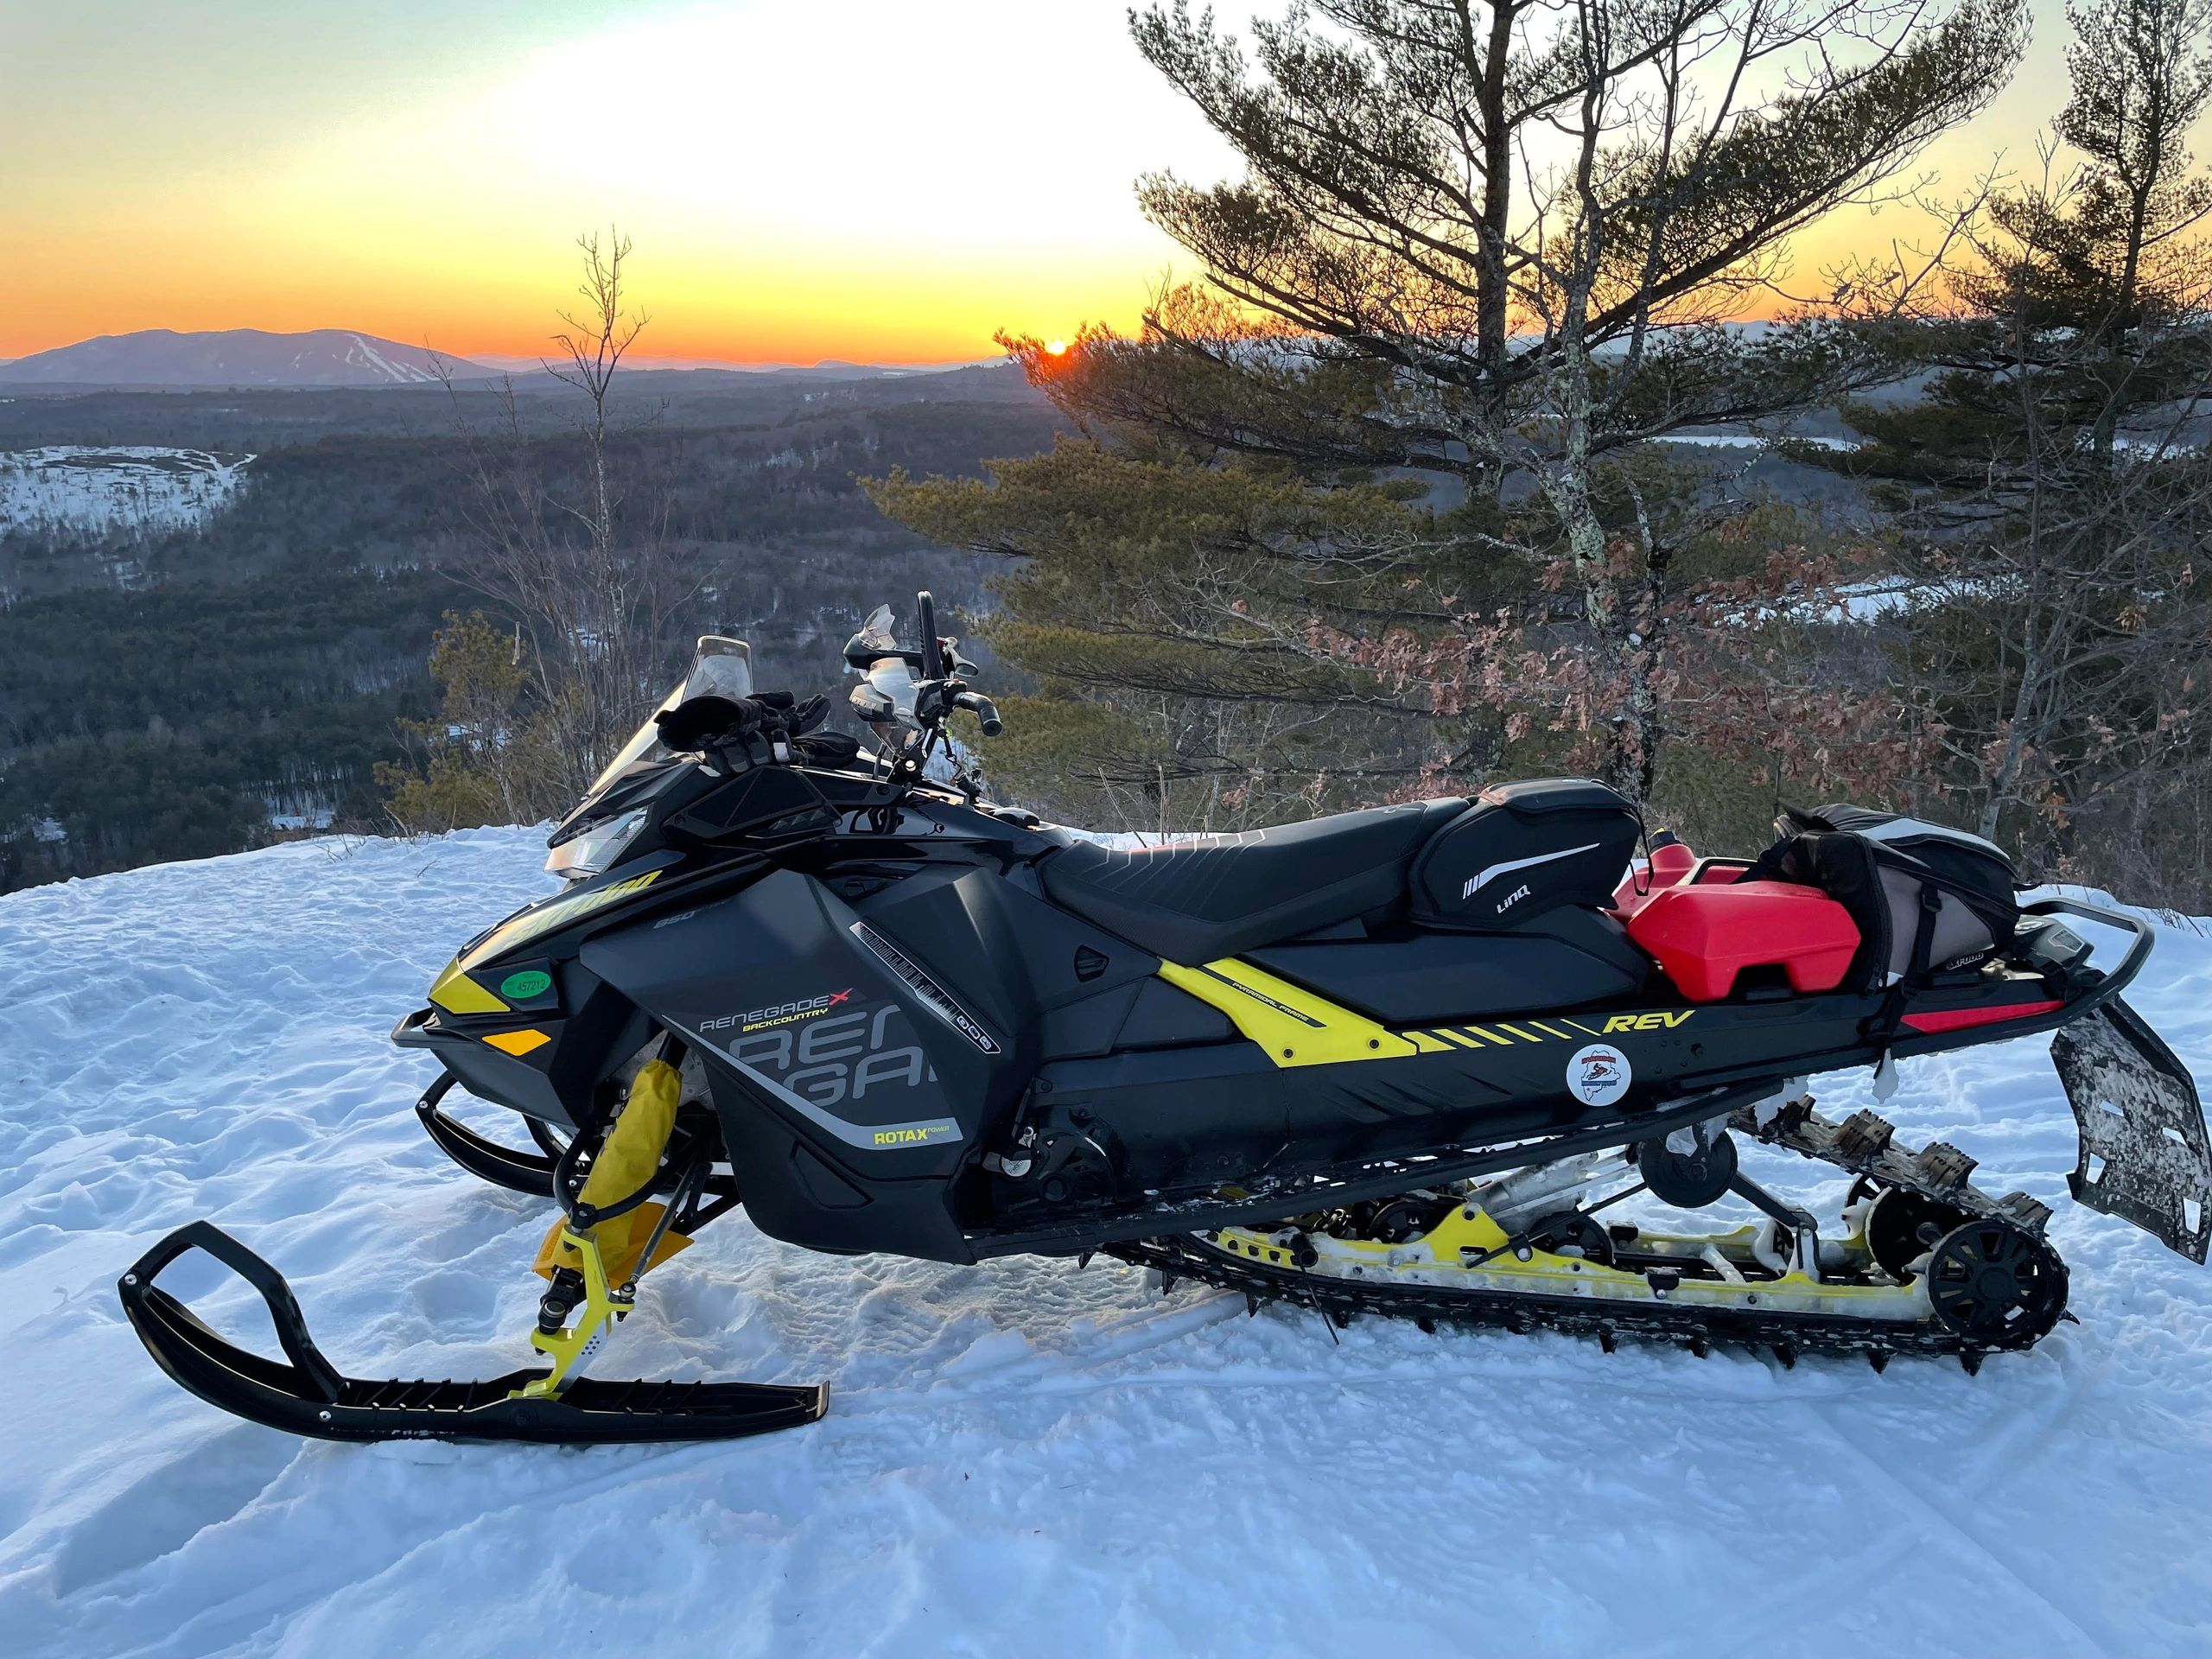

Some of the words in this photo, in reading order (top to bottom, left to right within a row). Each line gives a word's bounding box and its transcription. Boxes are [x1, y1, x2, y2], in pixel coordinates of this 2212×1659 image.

[517, 979, 546, 992] 457212
[1232, 982, 1277, 1007] PYRAMIDAL
[1279, 1005, 1309, 1022] FRAME
[742, 1007, 828, 1033] BACKCOUNTRY
[1602, 1009, 1696, 1033] REV
[783, 1046, 938, 1107] GA
[874, 1128, 928, 1145] ROTAX
[927, 1125, 950, 1134] POWER
